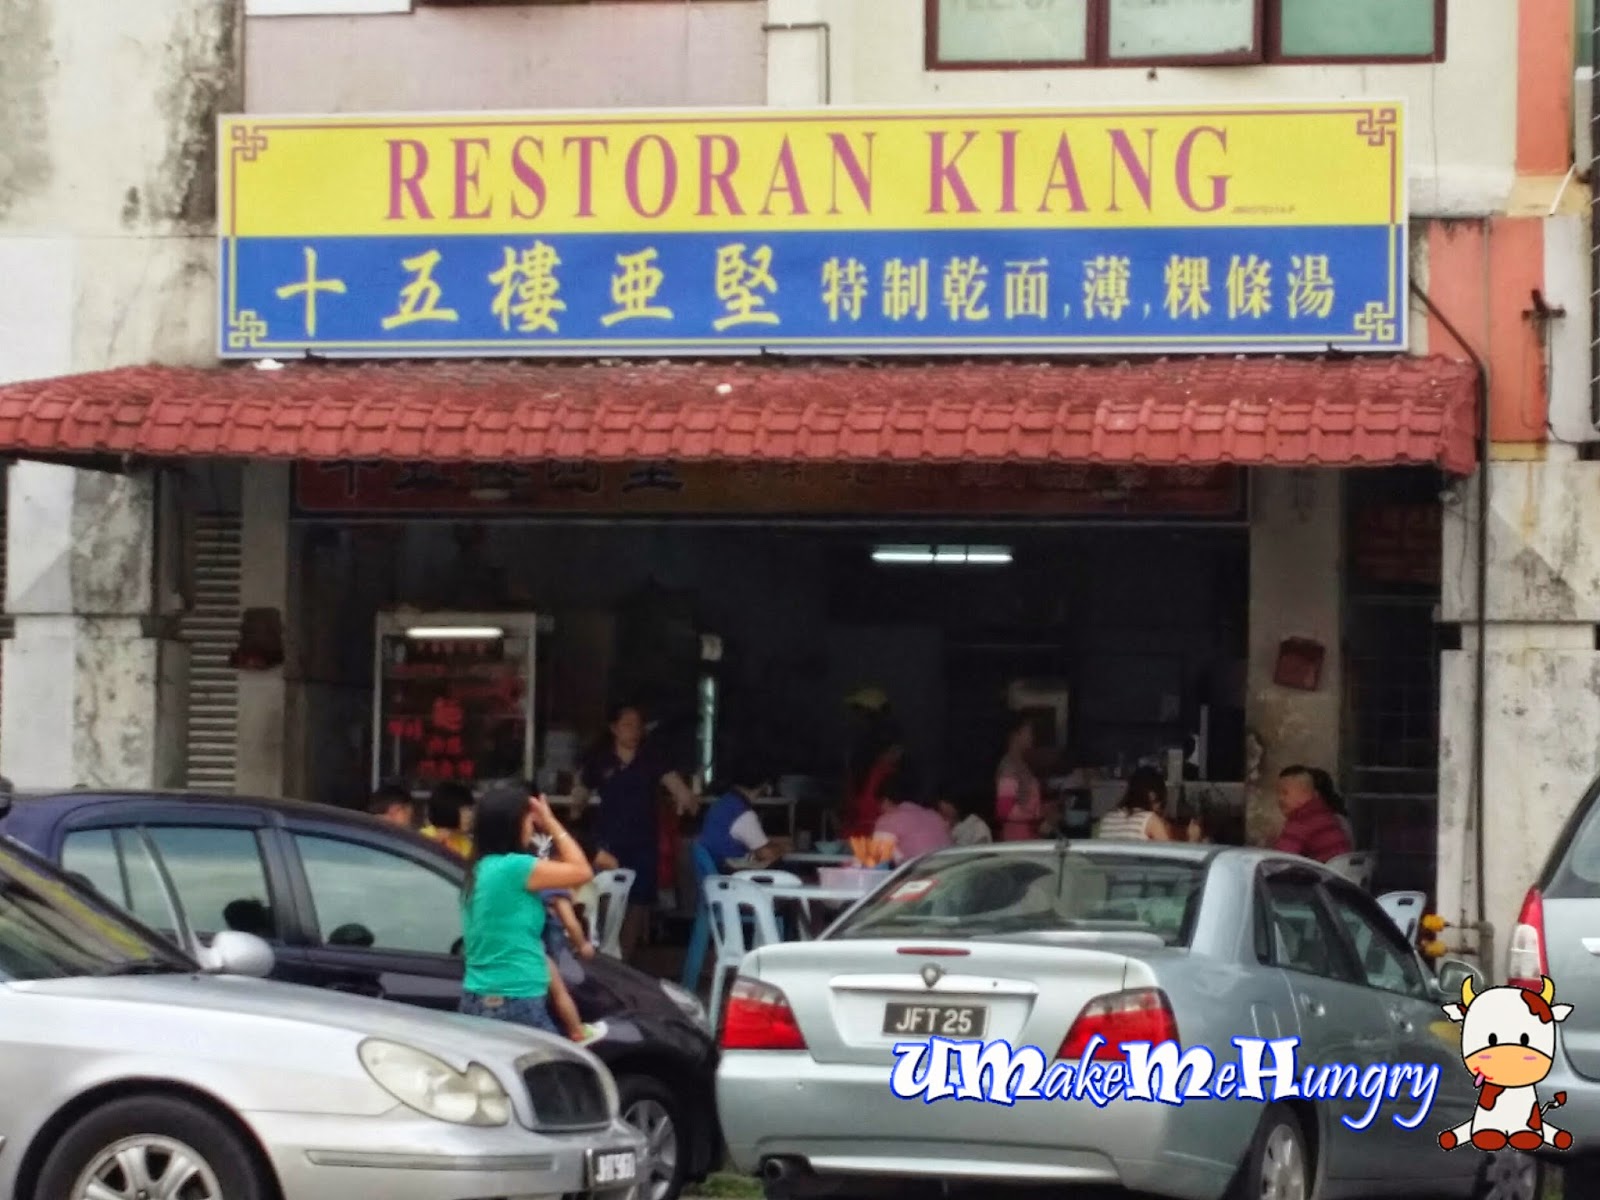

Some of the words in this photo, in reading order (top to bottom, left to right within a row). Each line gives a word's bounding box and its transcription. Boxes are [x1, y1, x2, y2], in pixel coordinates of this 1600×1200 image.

[384, 131, 874, 220] RESTORAN
[924, 126, 1233, 214] KIANG
[896, 1007, 940, 1032] JFT
[942, 1008, 973, 1033] 25
